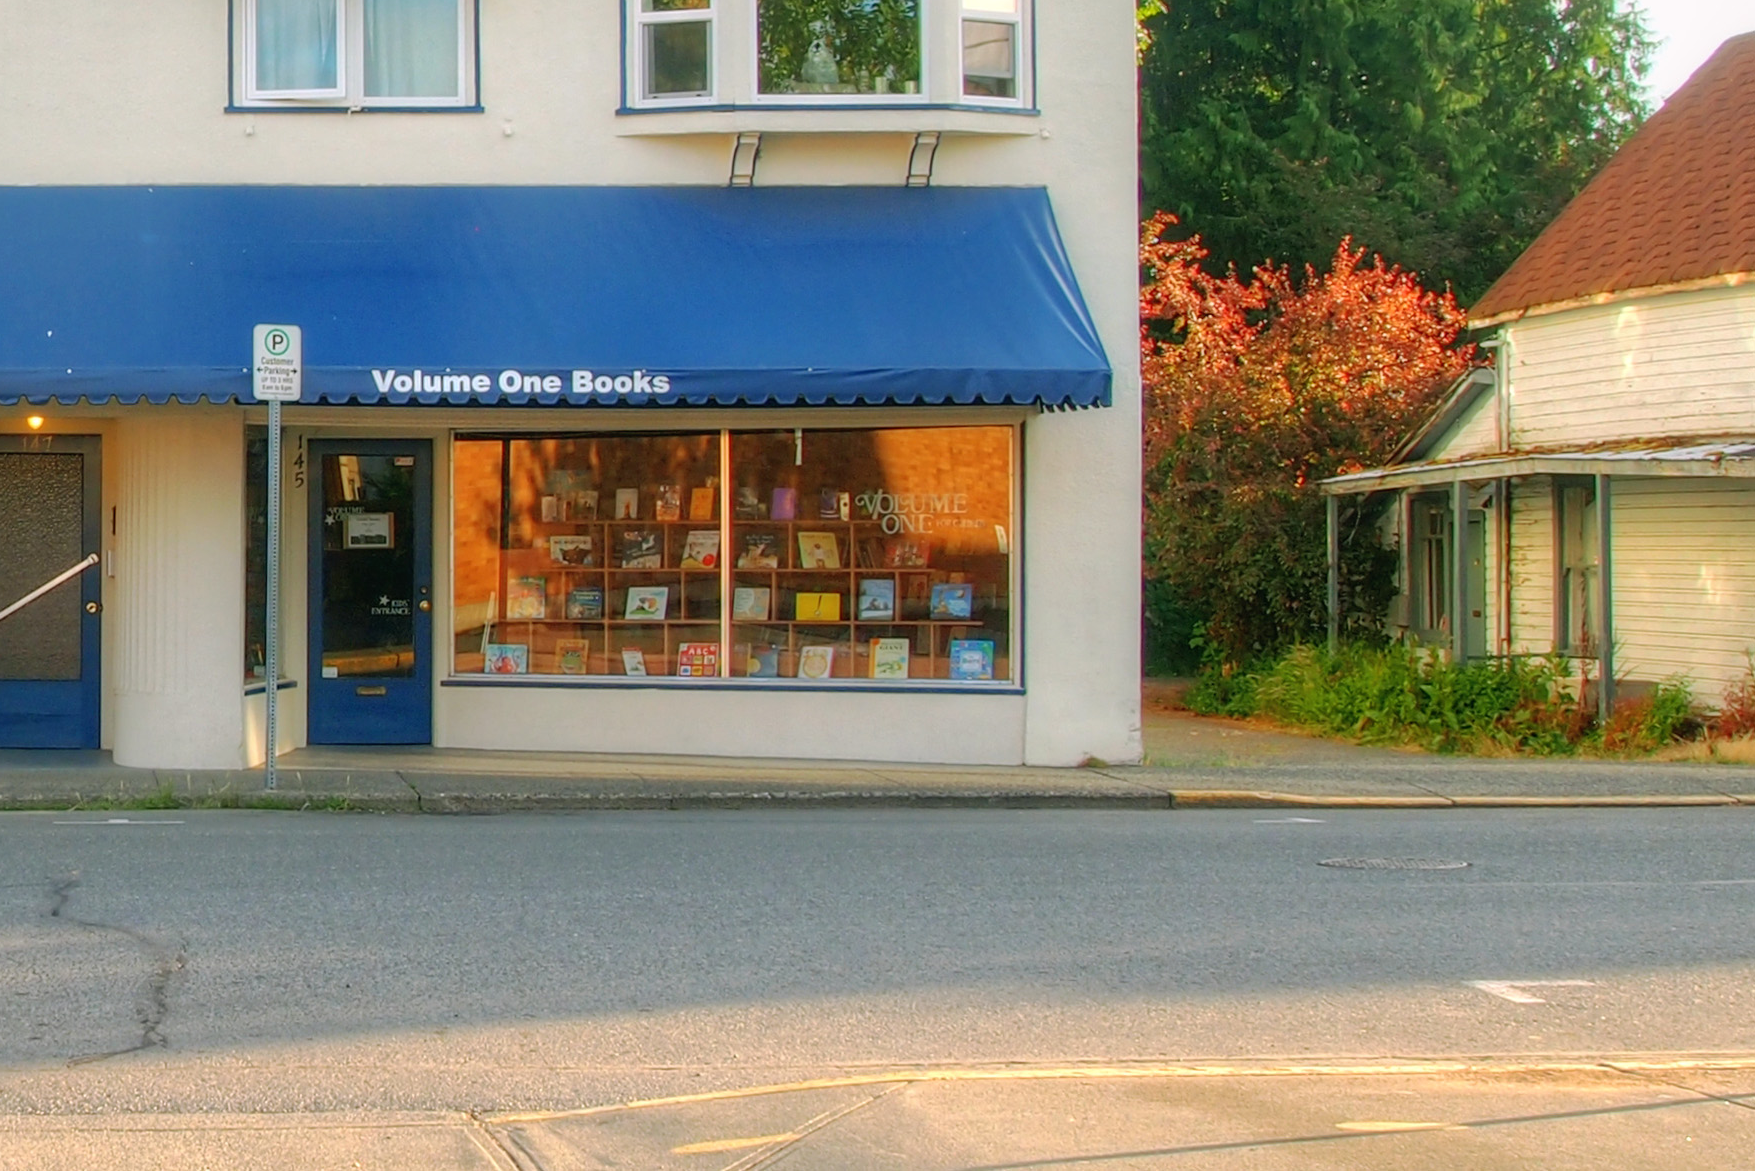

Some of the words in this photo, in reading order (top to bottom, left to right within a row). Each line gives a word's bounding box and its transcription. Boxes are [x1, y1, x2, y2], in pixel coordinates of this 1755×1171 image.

[272, 334, 284, 351] P
[260, 356, 294, 366] Customer
[263, 366, 291, 377] Parking
[371, 369, 492, 394] Volume
[498, 369, 563, 394] One
[571, 370, 671, 394] Books
[293, 434, 305, 488] 145
[854, 491, 968, 515] VOLUME
[880, 513, 934, 535] ONE
[370, 606, 412, 616] ENTRANCE
